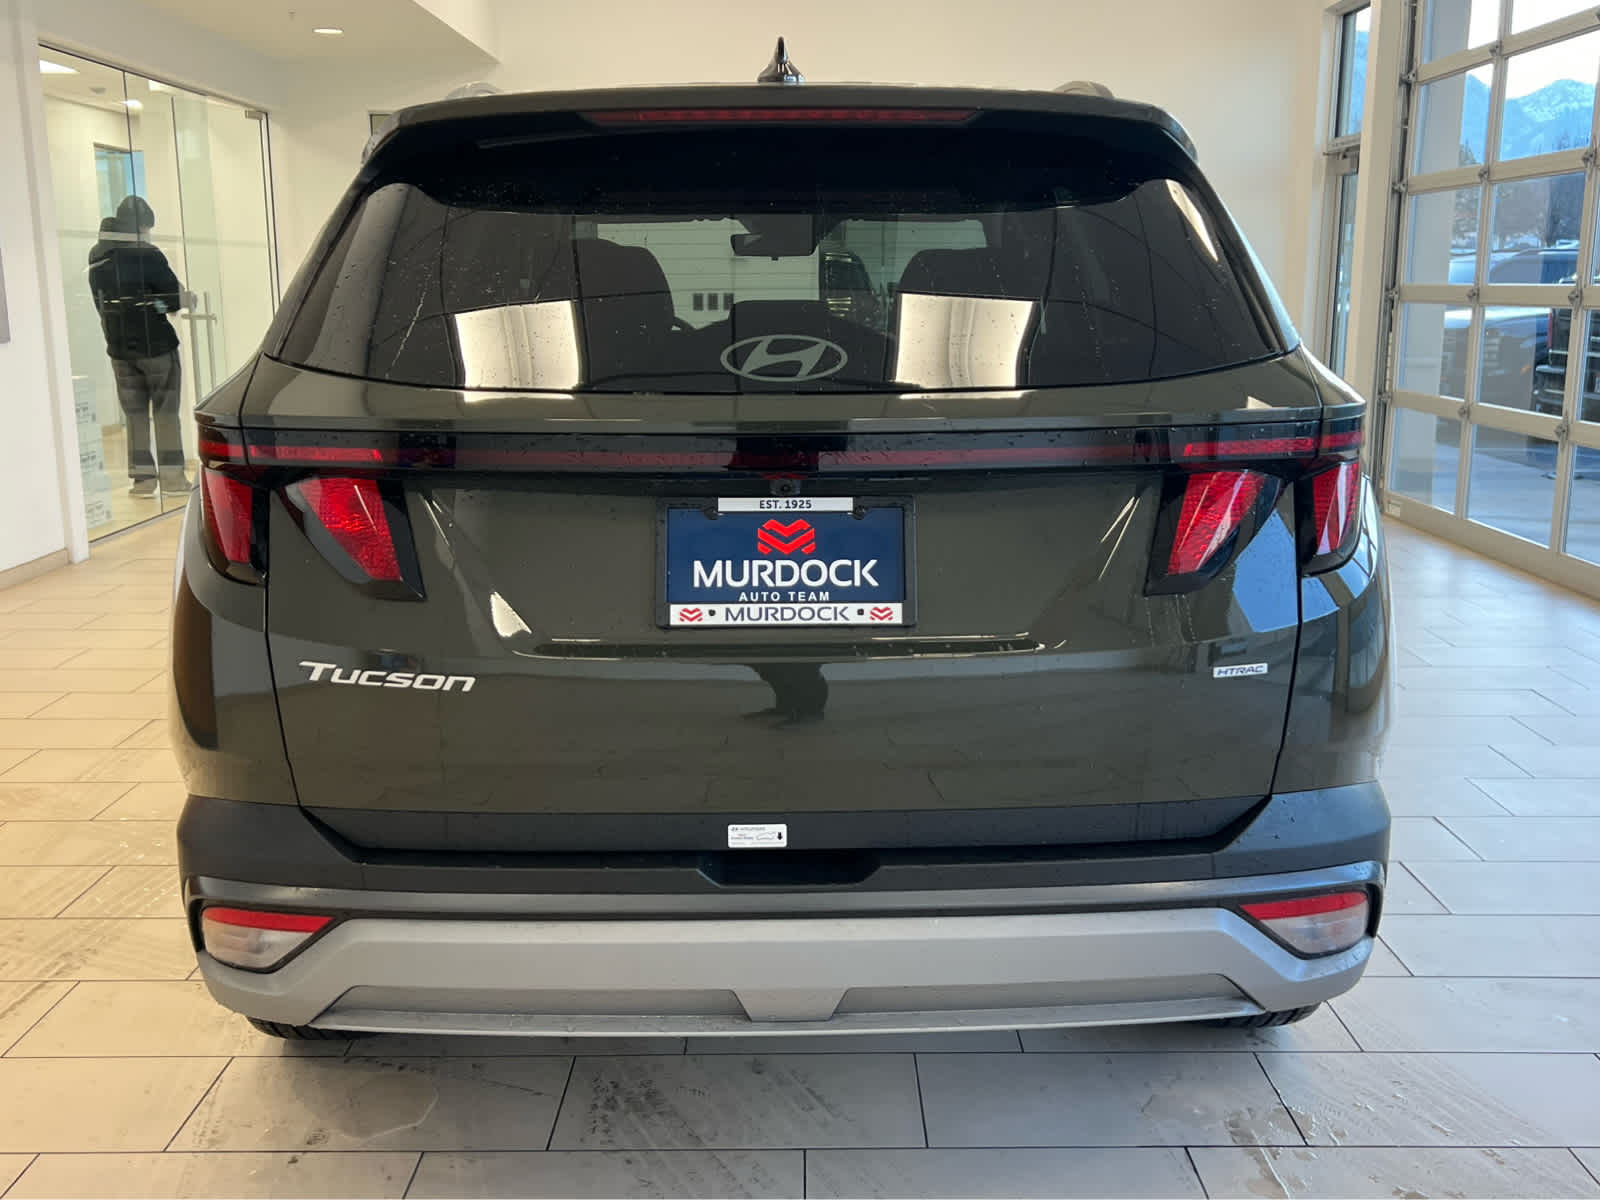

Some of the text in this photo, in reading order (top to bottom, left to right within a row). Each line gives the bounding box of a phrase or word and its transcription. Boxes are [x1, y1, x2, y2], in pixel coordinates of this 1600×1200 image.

[759, 500, 812, 509] EST. 1925
[693, 559, 879, 588] MURDOCK
[738, 591, 830, 602] AUTO TEAM
[724, 606, 850, 622] MURDOCK
[1216, 665, 1264, 676] HTRAC
